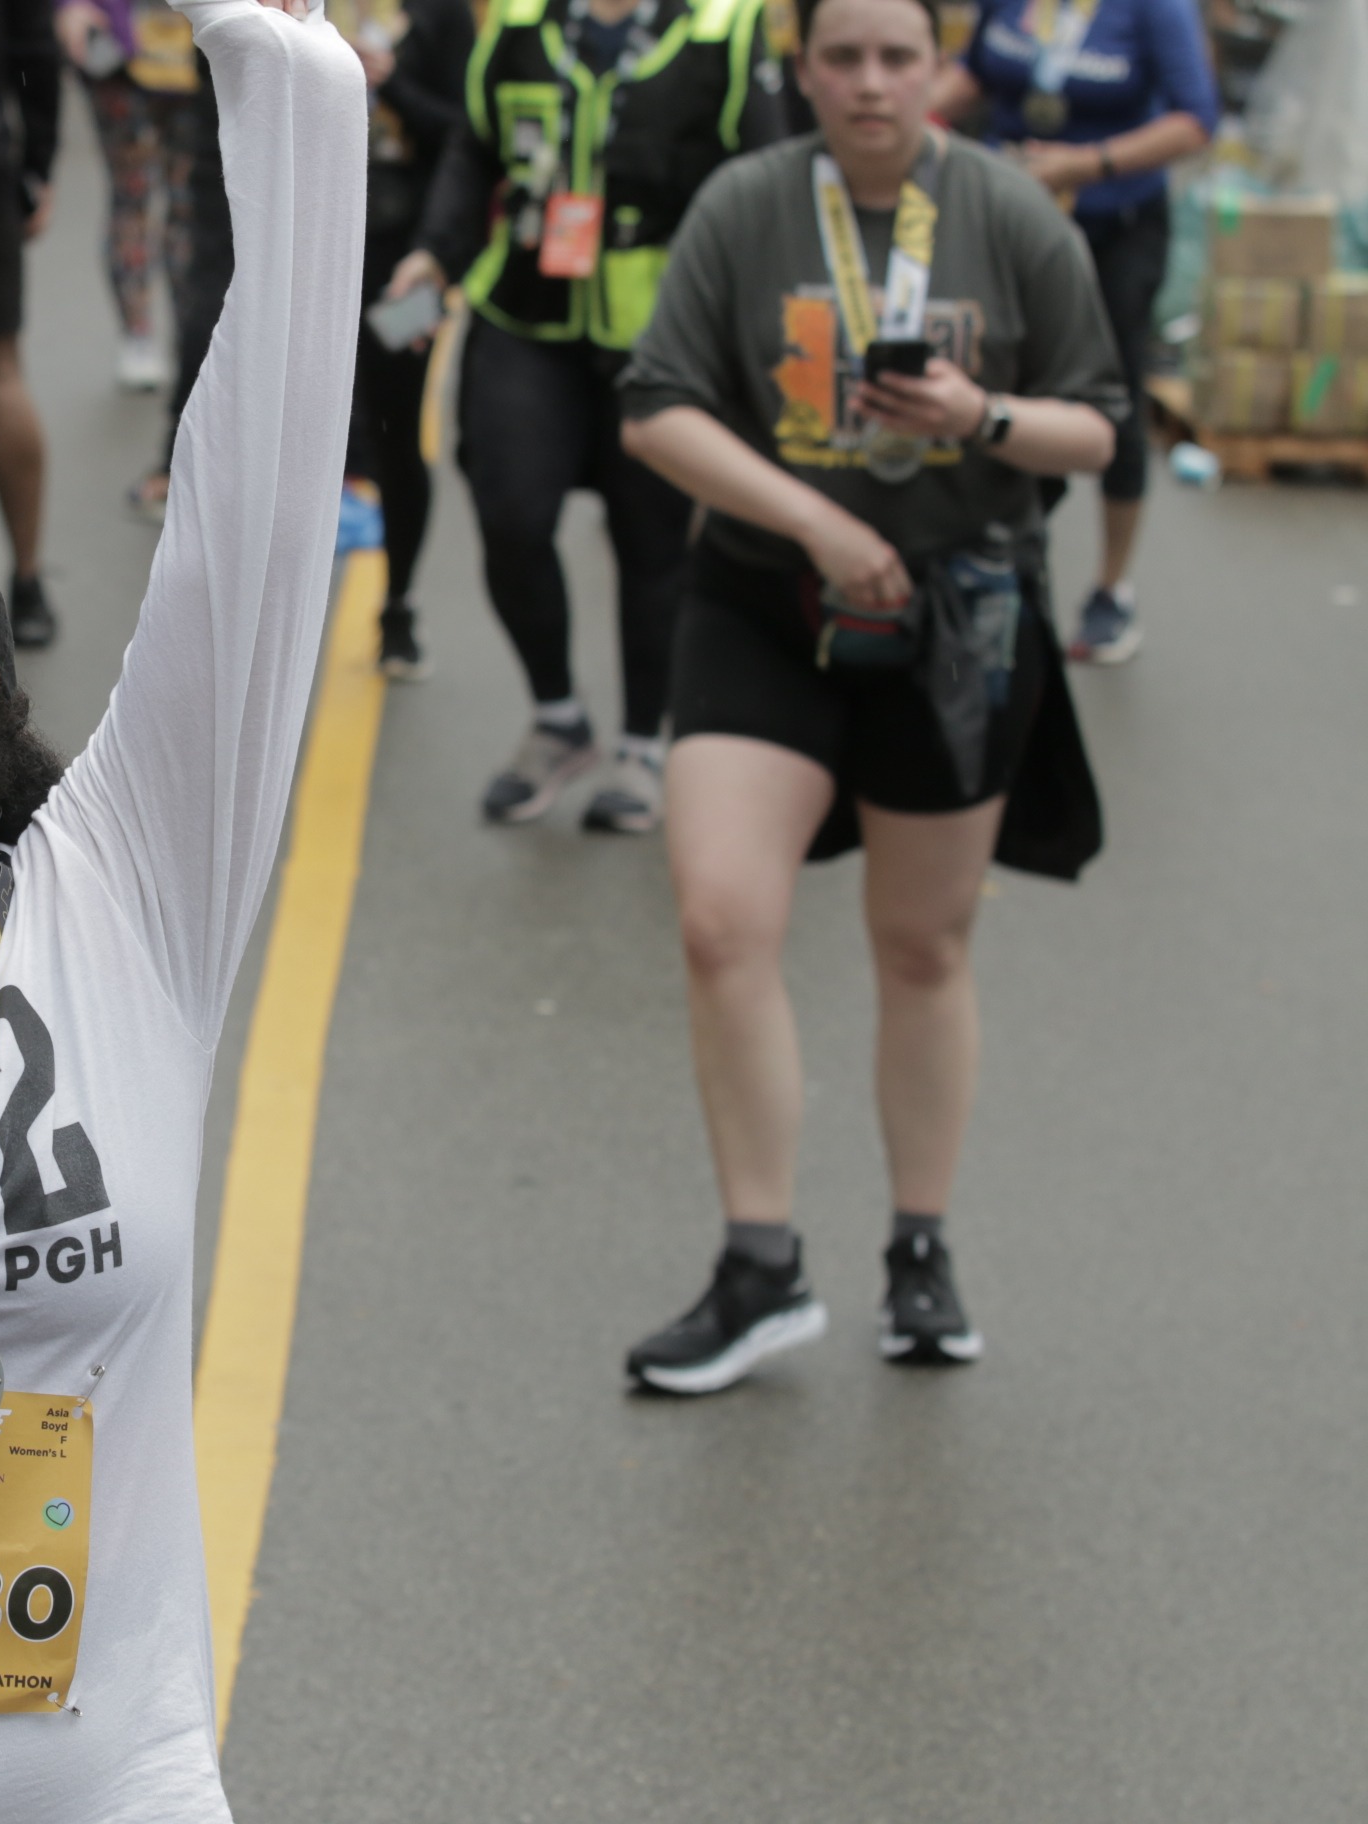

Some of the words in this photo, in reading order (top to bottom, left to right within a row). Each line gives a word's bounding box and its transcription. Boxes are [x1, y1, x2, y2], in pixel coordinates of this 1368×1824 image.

[5, 1221, 123, 1291] PGH
[46, 1408, 70, 1419] Asia
[41, 1420, 68, 1432] Boyd
[60, 1436, 68, 1445] F
[8, 1446, 57, 1458] Women's
[59, 1449, 67, 1458] L
